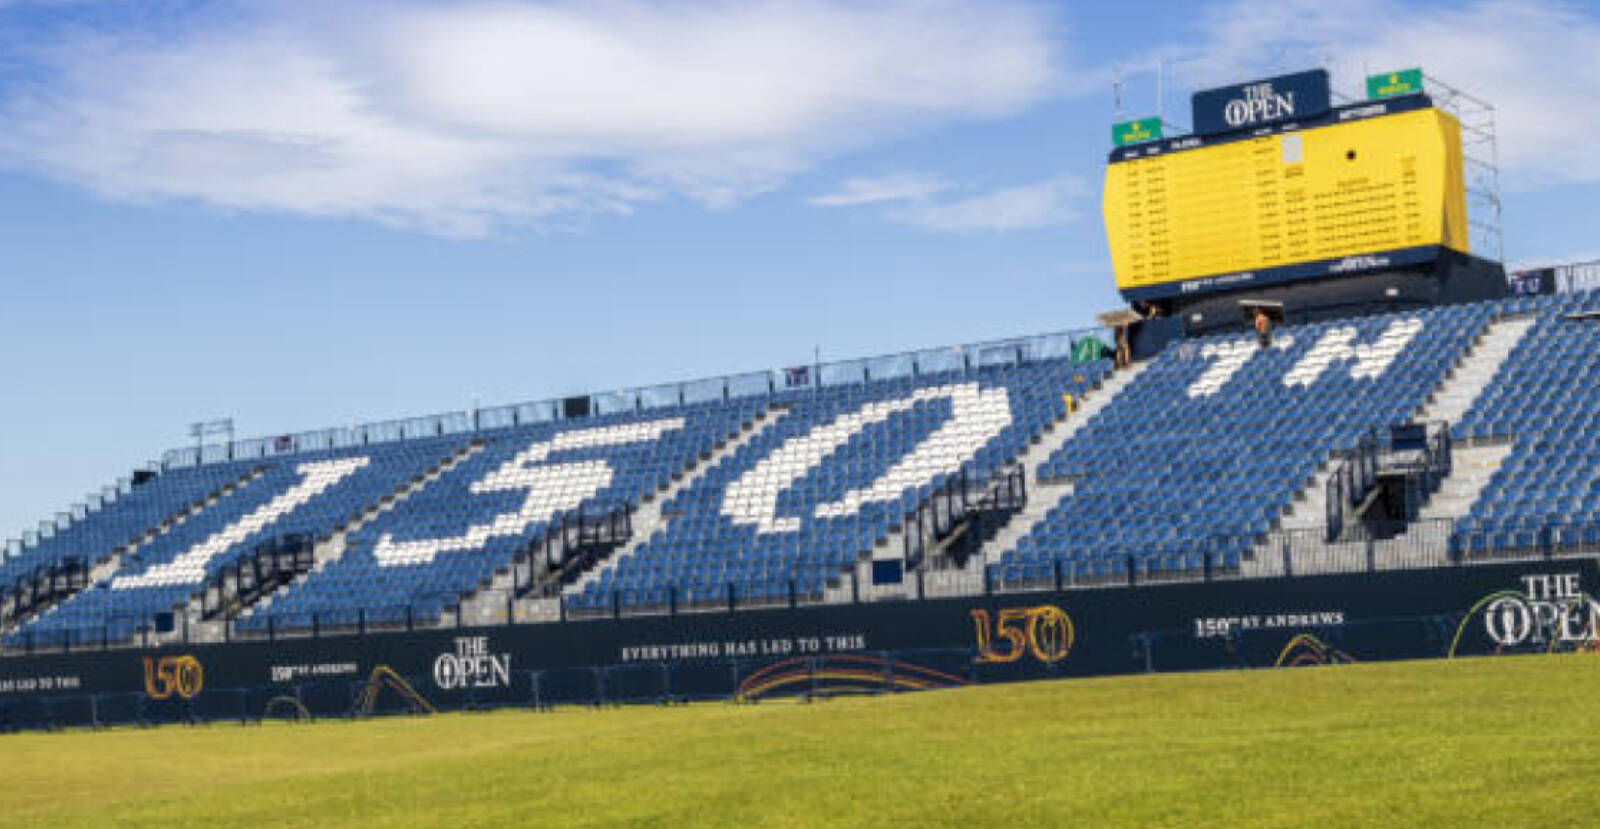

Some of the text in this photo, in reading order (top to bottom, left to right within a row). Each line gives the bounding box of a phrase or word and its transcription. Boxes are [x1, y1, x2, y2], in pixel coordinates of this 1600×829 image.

[1243, 83, 1273, 100] THE
[1225, 91, 1294, 127] OPEN
[1521, 574, 1582, 600] THE
[1265, 611, 1344, 627] ANDREWS
[455, 636, 489, 657] THE
[622, 634, 865, 661] EVERYTHING HAS LED TO THIS
[970, 605, 1074, 664] 150
[142, 654, 203, 699] 150
[434, 653, 511, 689] OPEN
